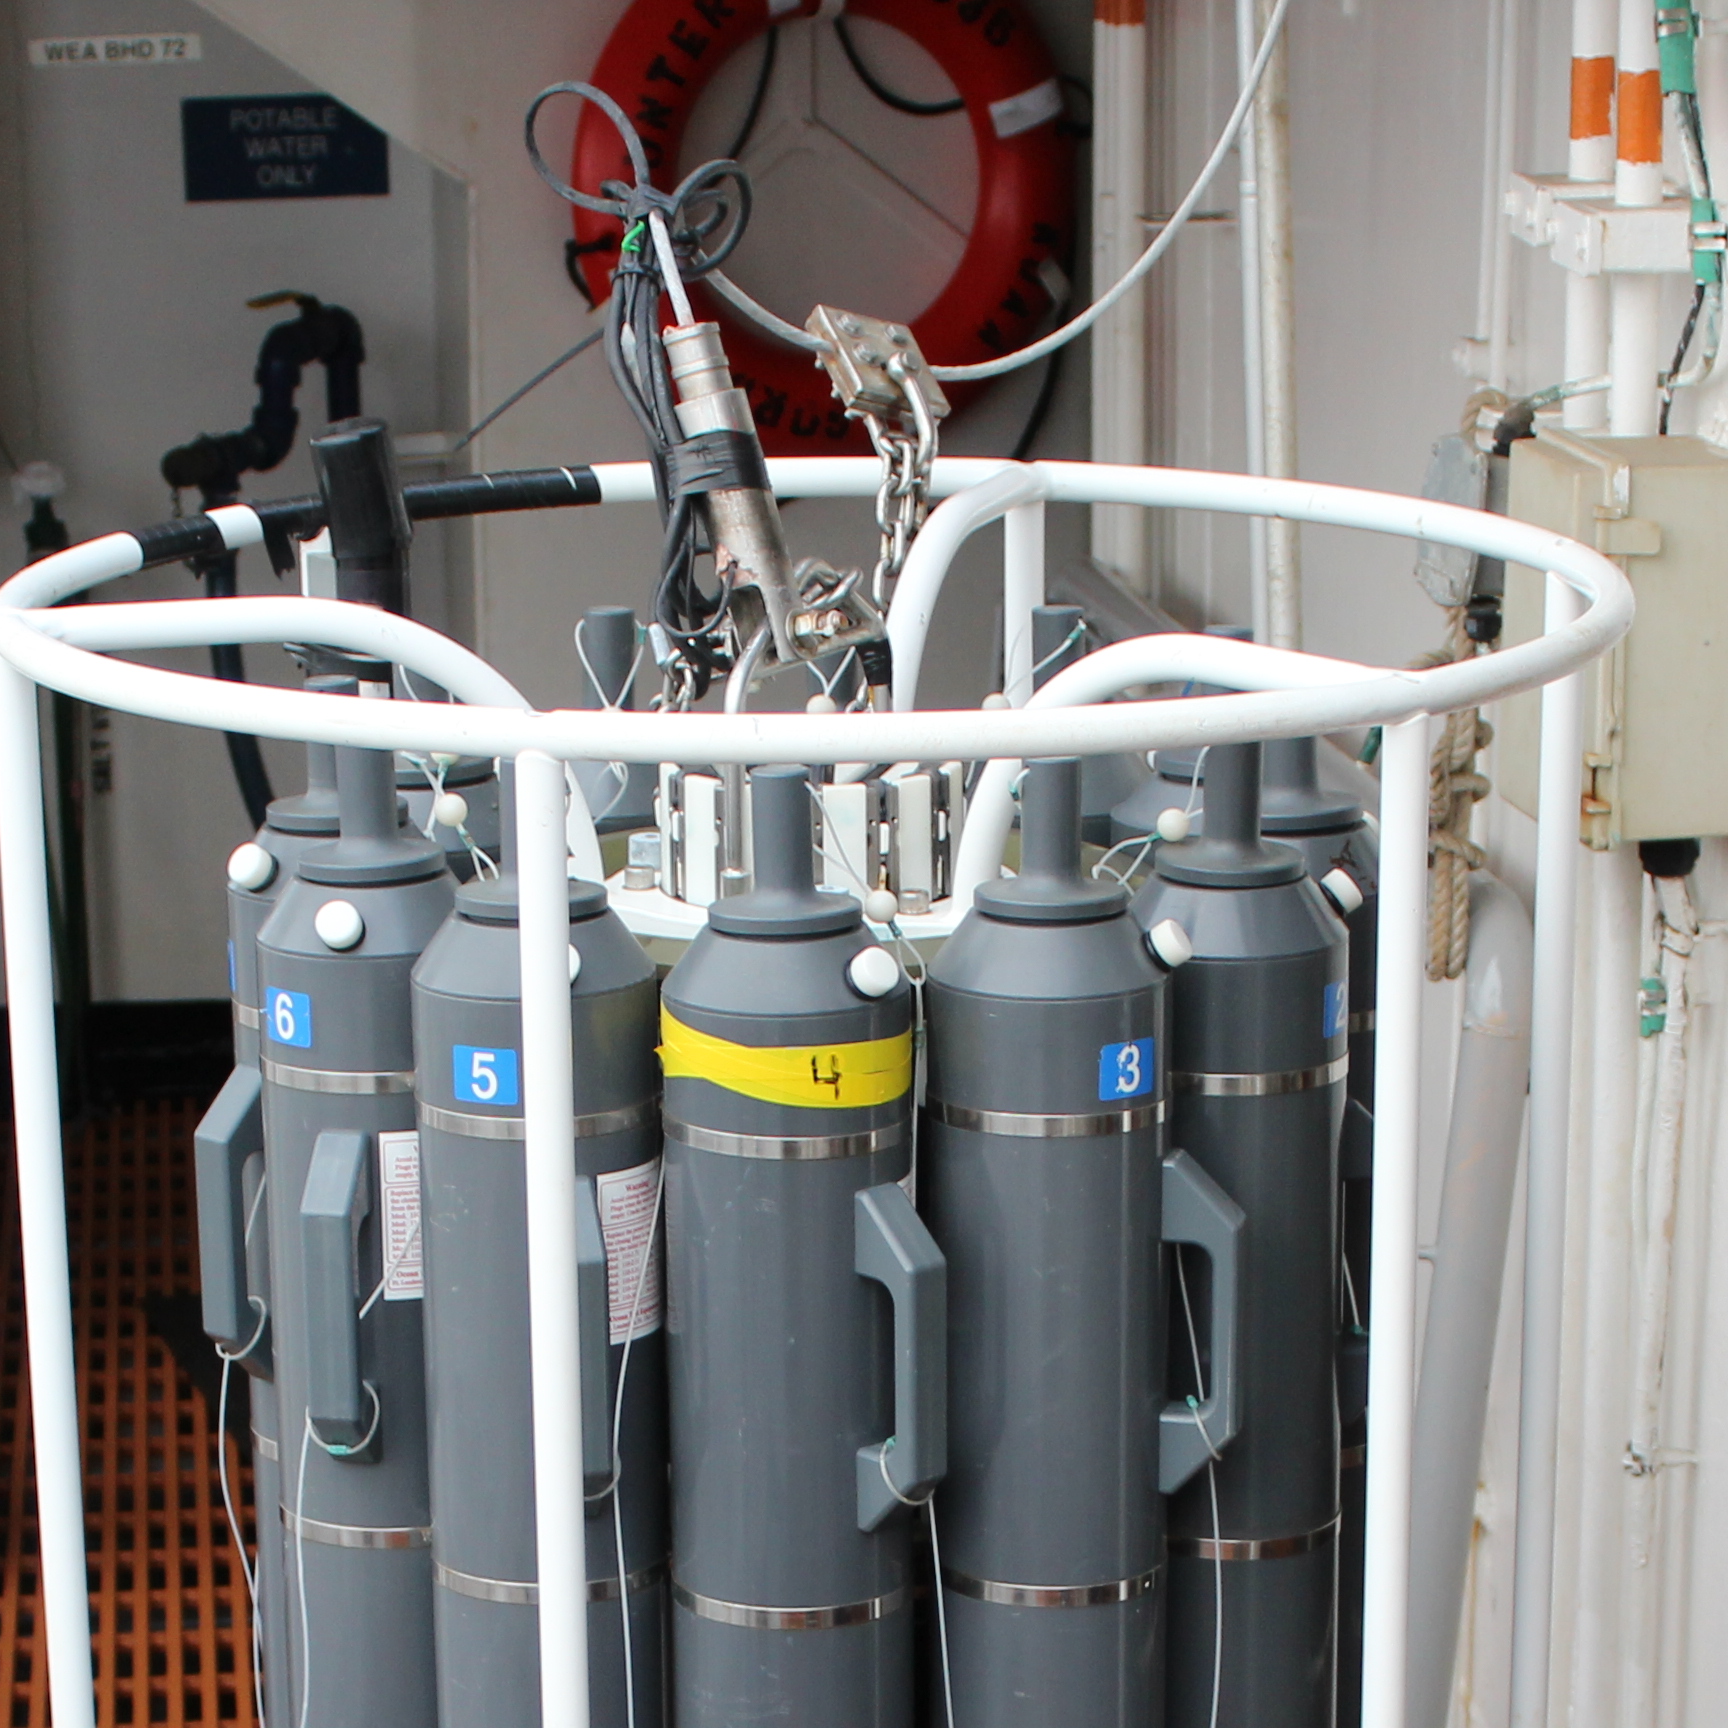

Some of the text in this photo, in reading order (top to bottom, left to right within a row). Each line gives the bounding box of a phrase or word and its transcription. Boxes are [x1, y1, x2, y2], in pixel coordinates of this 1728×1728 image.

[44, 41, 97, 60] WEA
[622, 0, 736, 169] UNTER
[229, 106, 339, 130] POTABLE
[244, 135, 330, 158] WATER
[256, 164, 319, 186] ONLY
[274, 992, 296, 1040] 6
[471, 1052, 498, 1100] 5
[811, 1054, 840, 1100] 4
[1117, 1043, 1141, 1094] 3
